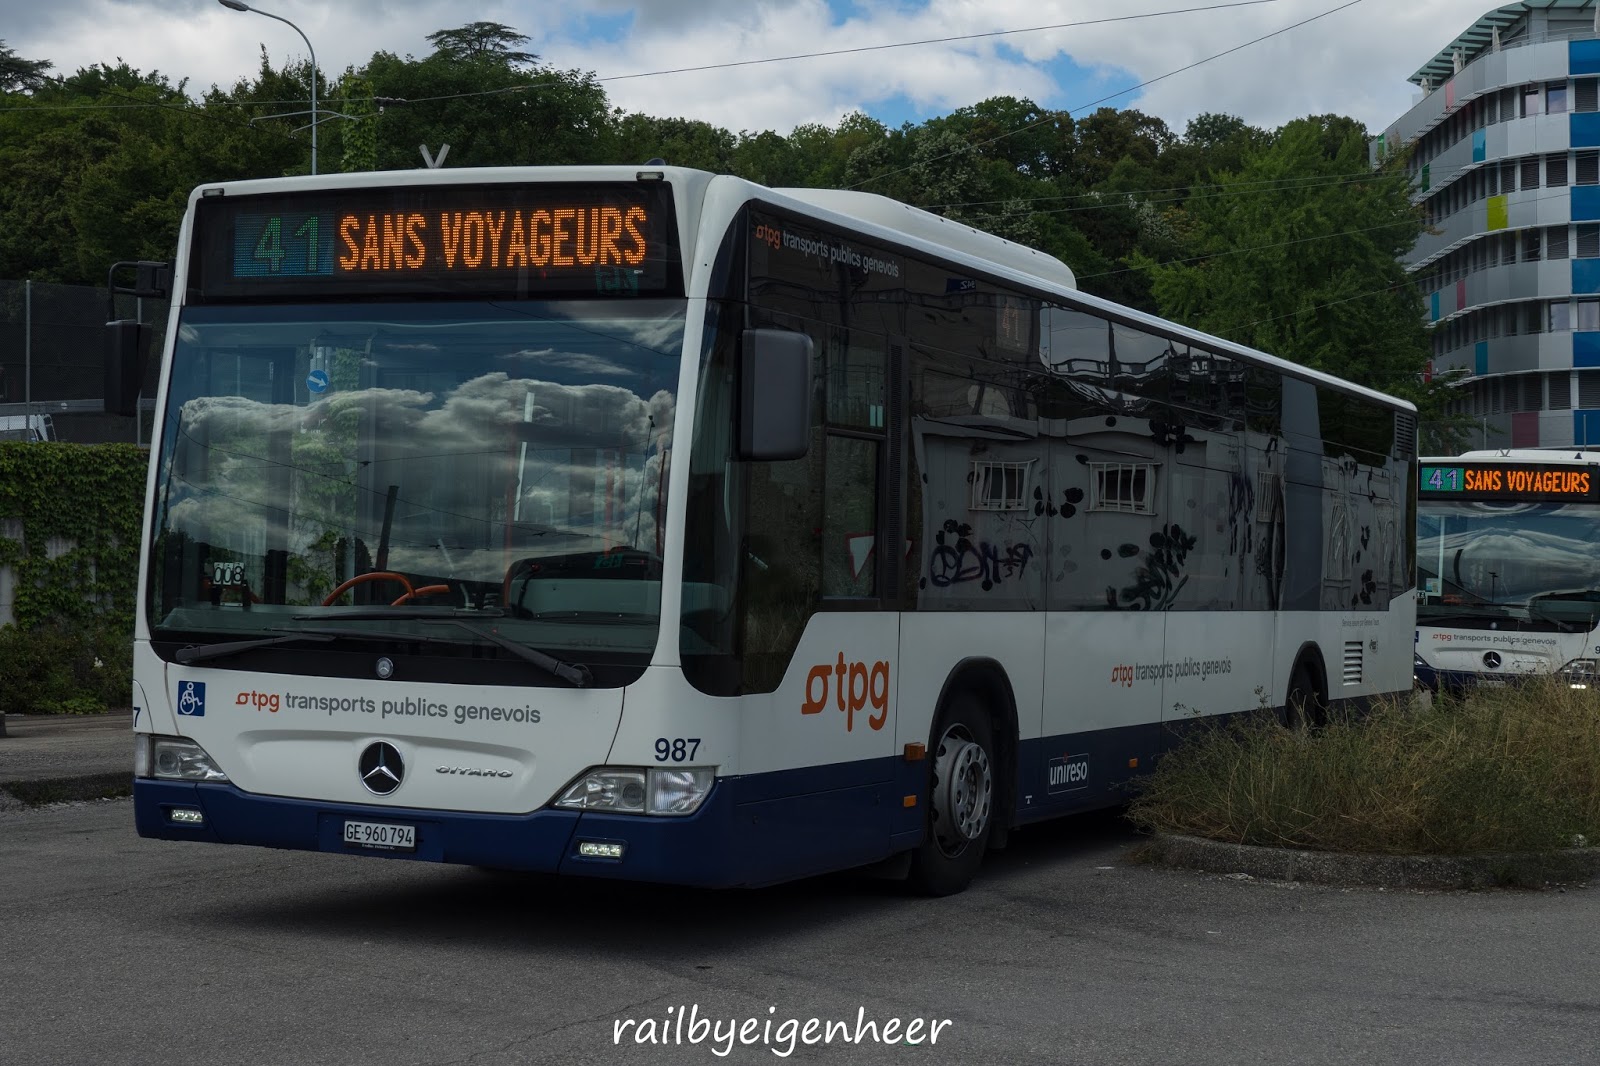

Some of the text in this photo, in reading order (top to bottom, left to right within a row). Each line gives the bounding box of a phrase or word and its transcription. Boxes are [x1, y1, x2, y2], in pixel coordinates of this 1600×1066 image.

[254, 206, 647, 271] 41 SANS VOYAGEURS
[783, 231, 829, 258] transports
[830, 243, 861, 267] publics
[863, 256, 899, 278] genevois
[1428, 468, 1590, 494] 41 SANS VOYAGEURS
[214, 565, 243, 583] 008
[1453, 633, 1491, 643] transports
[1493, 635, 1520, 644] publics
[1522, 637, 1557, 645] genevois
[1135, 661, 1173, 685] transports
[1174, 657, 1200, 683] publics
[1201, 656, 1231, 681] genevois
[285, 692, 376, 716] transports
[381, 697, 449, 719] publics
[454, 704, 541, 725] genevois
[654, 738, 701, 762] 987
[435, 765, 514, 778] CITARO
[1050, 759, 1088, 786] unireso
